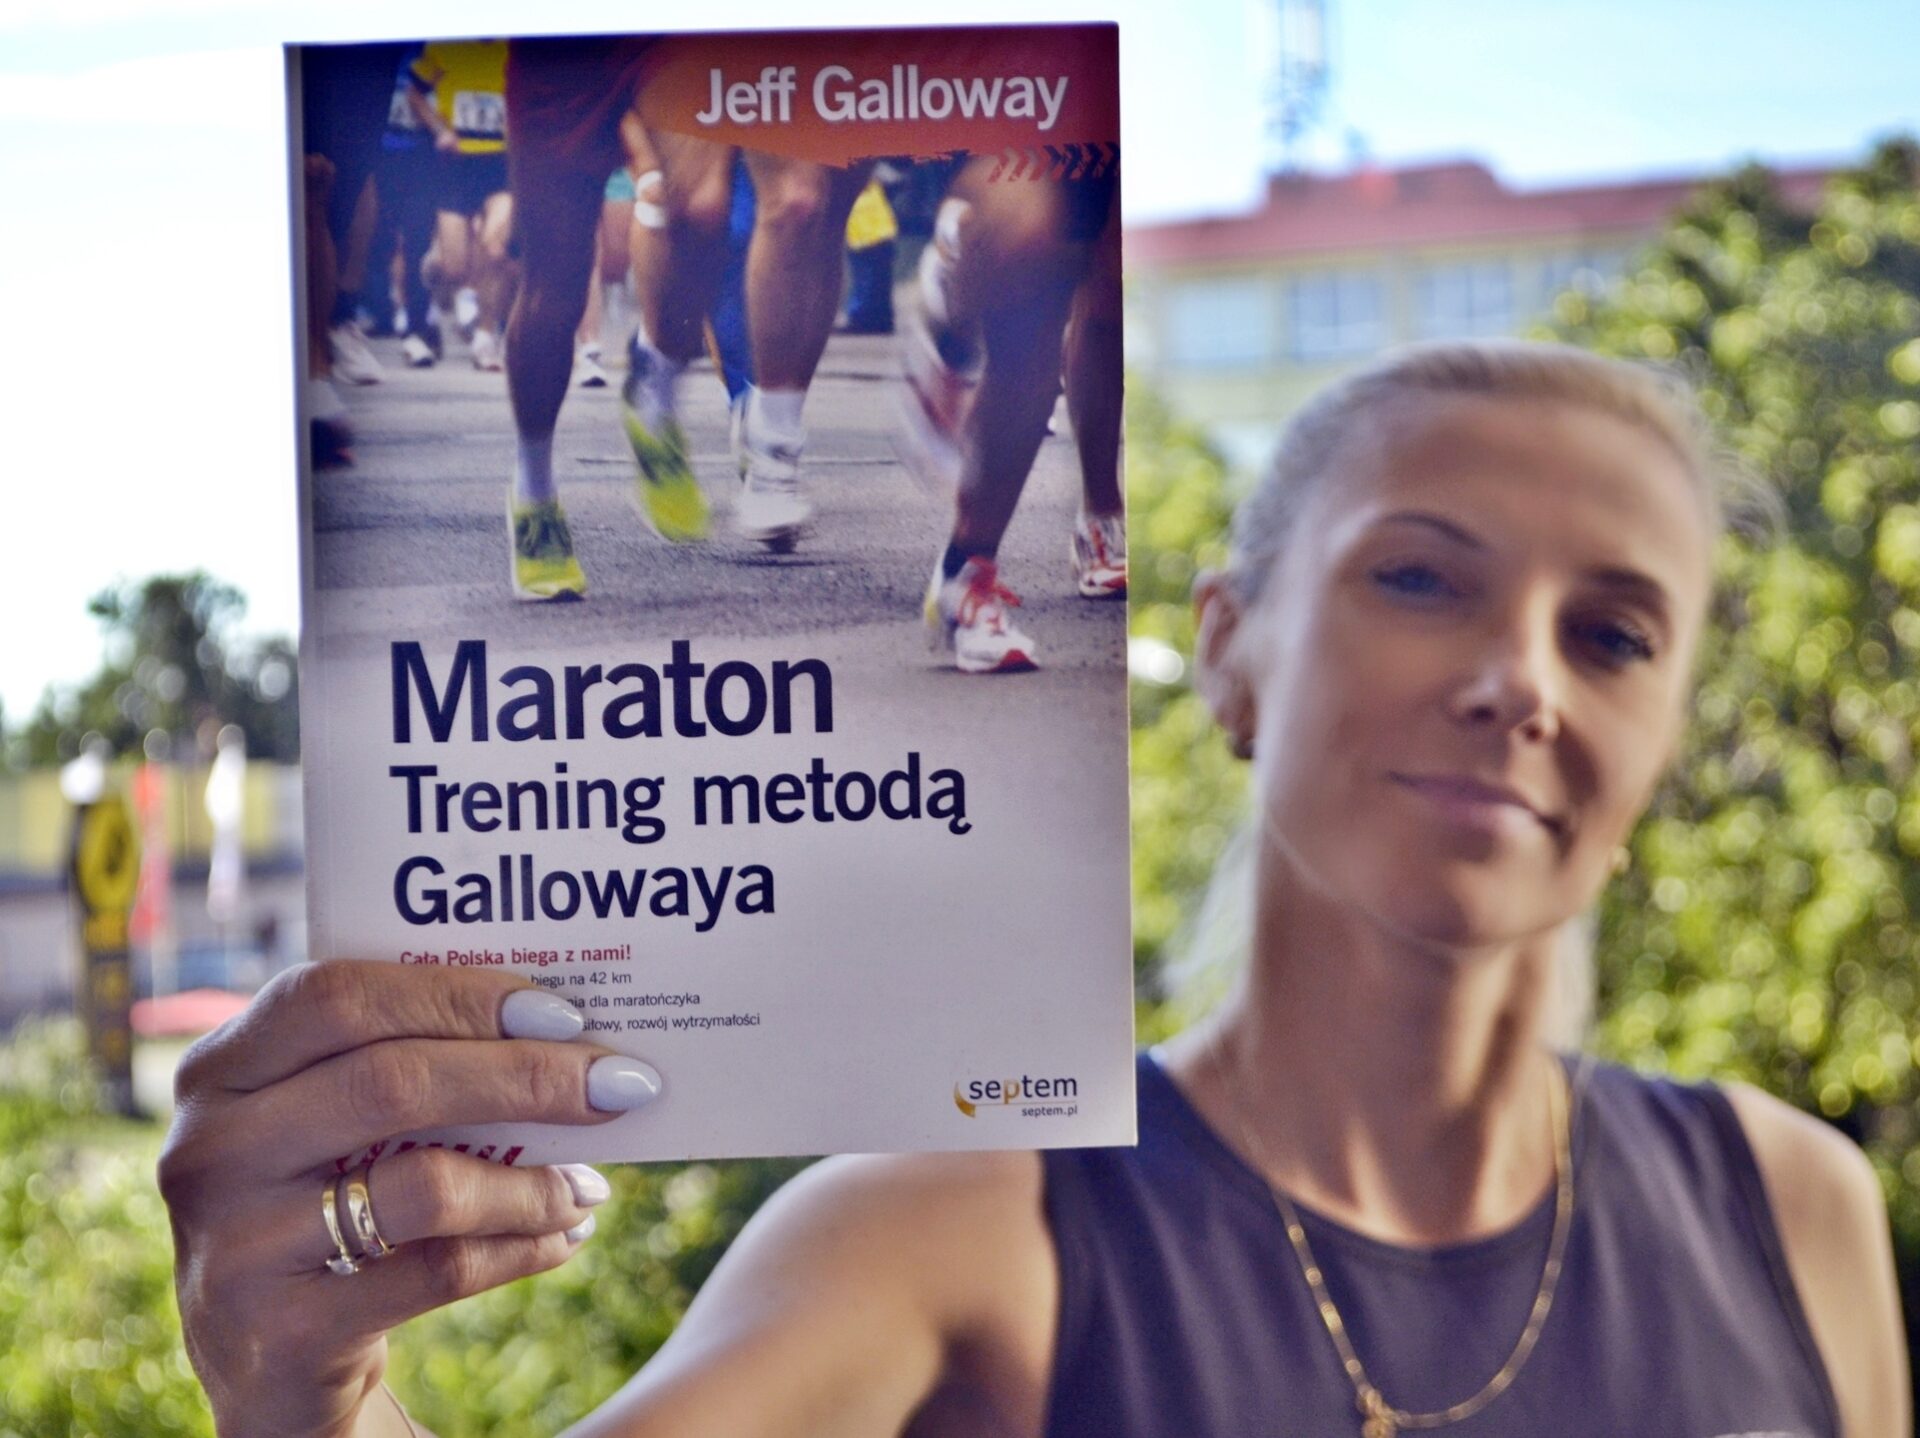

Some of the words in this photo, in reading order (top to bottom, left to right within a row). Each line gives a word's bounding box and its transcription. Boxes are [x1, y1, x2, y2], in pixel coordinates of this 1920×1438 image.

[695, 66, 796, 124] Jeff
[813, 64, 1069, 130] Galloway
[390, 639, 834, 744] Maraton
[389, 762, 666, 844] Trening
[693, 751, 972, 835] metodą
[393, 854, 775, 932] Gallowaya
[447, 949, 504, 966] Polska
[511, 948, 558, 966] biega
[565, 950, 574, 962] z
[581, 944, 631, 962] nami!
[569, 974, 585, 985] na
[589, 971, 607, 984] 42
[612, 971, 632, 984] km
[589, 995, 609, 1008] dla
[613, 992, 700, 1010] maratończyka
[627, 1015, 667, 1031] rozwój
[672, 1012, 760, 1030] wytrzymałości
[969, 1074, 1077, 1104] septem
[1021, 1105, 1078, 1118] septem.pl
